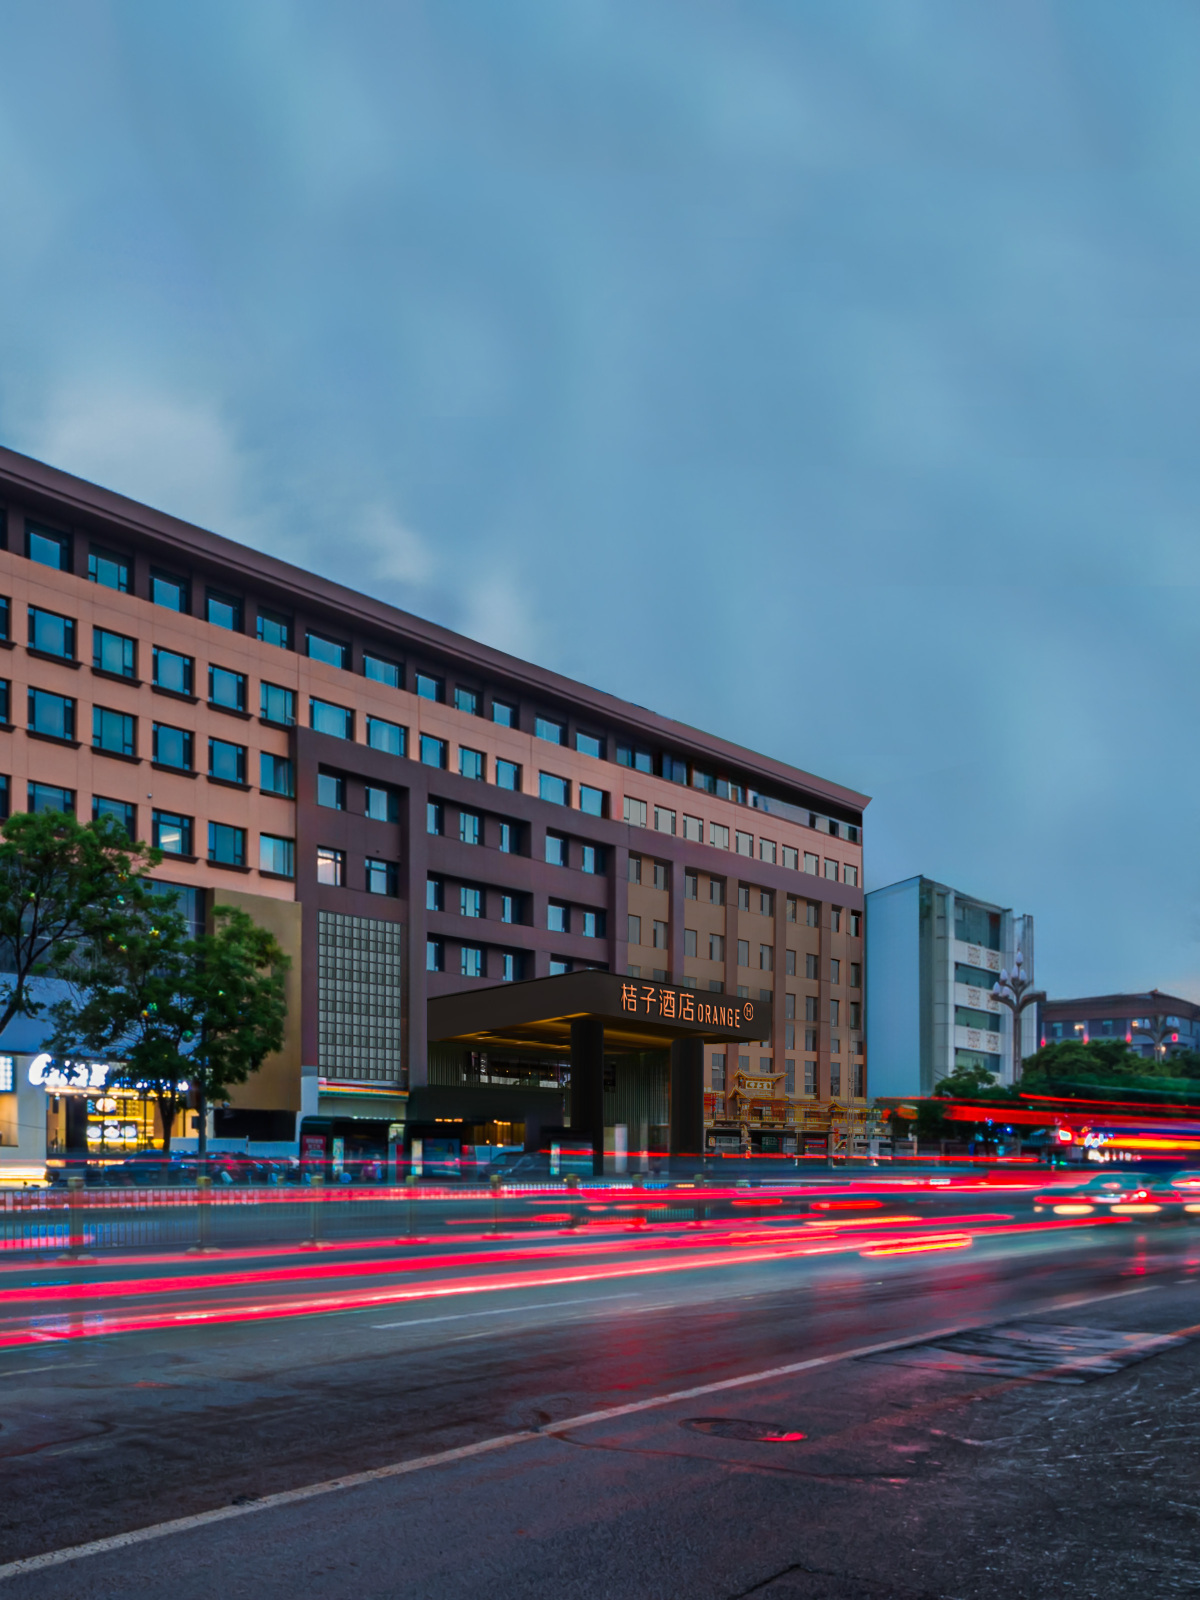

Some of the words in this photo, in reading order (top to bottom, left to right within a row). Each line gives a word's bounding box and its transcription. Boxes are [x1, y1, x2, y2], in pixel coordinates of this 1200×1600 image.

[620, 983, 694, 1022] 桔子酒店
[697, 1003, 741, 1028] ORANGE
